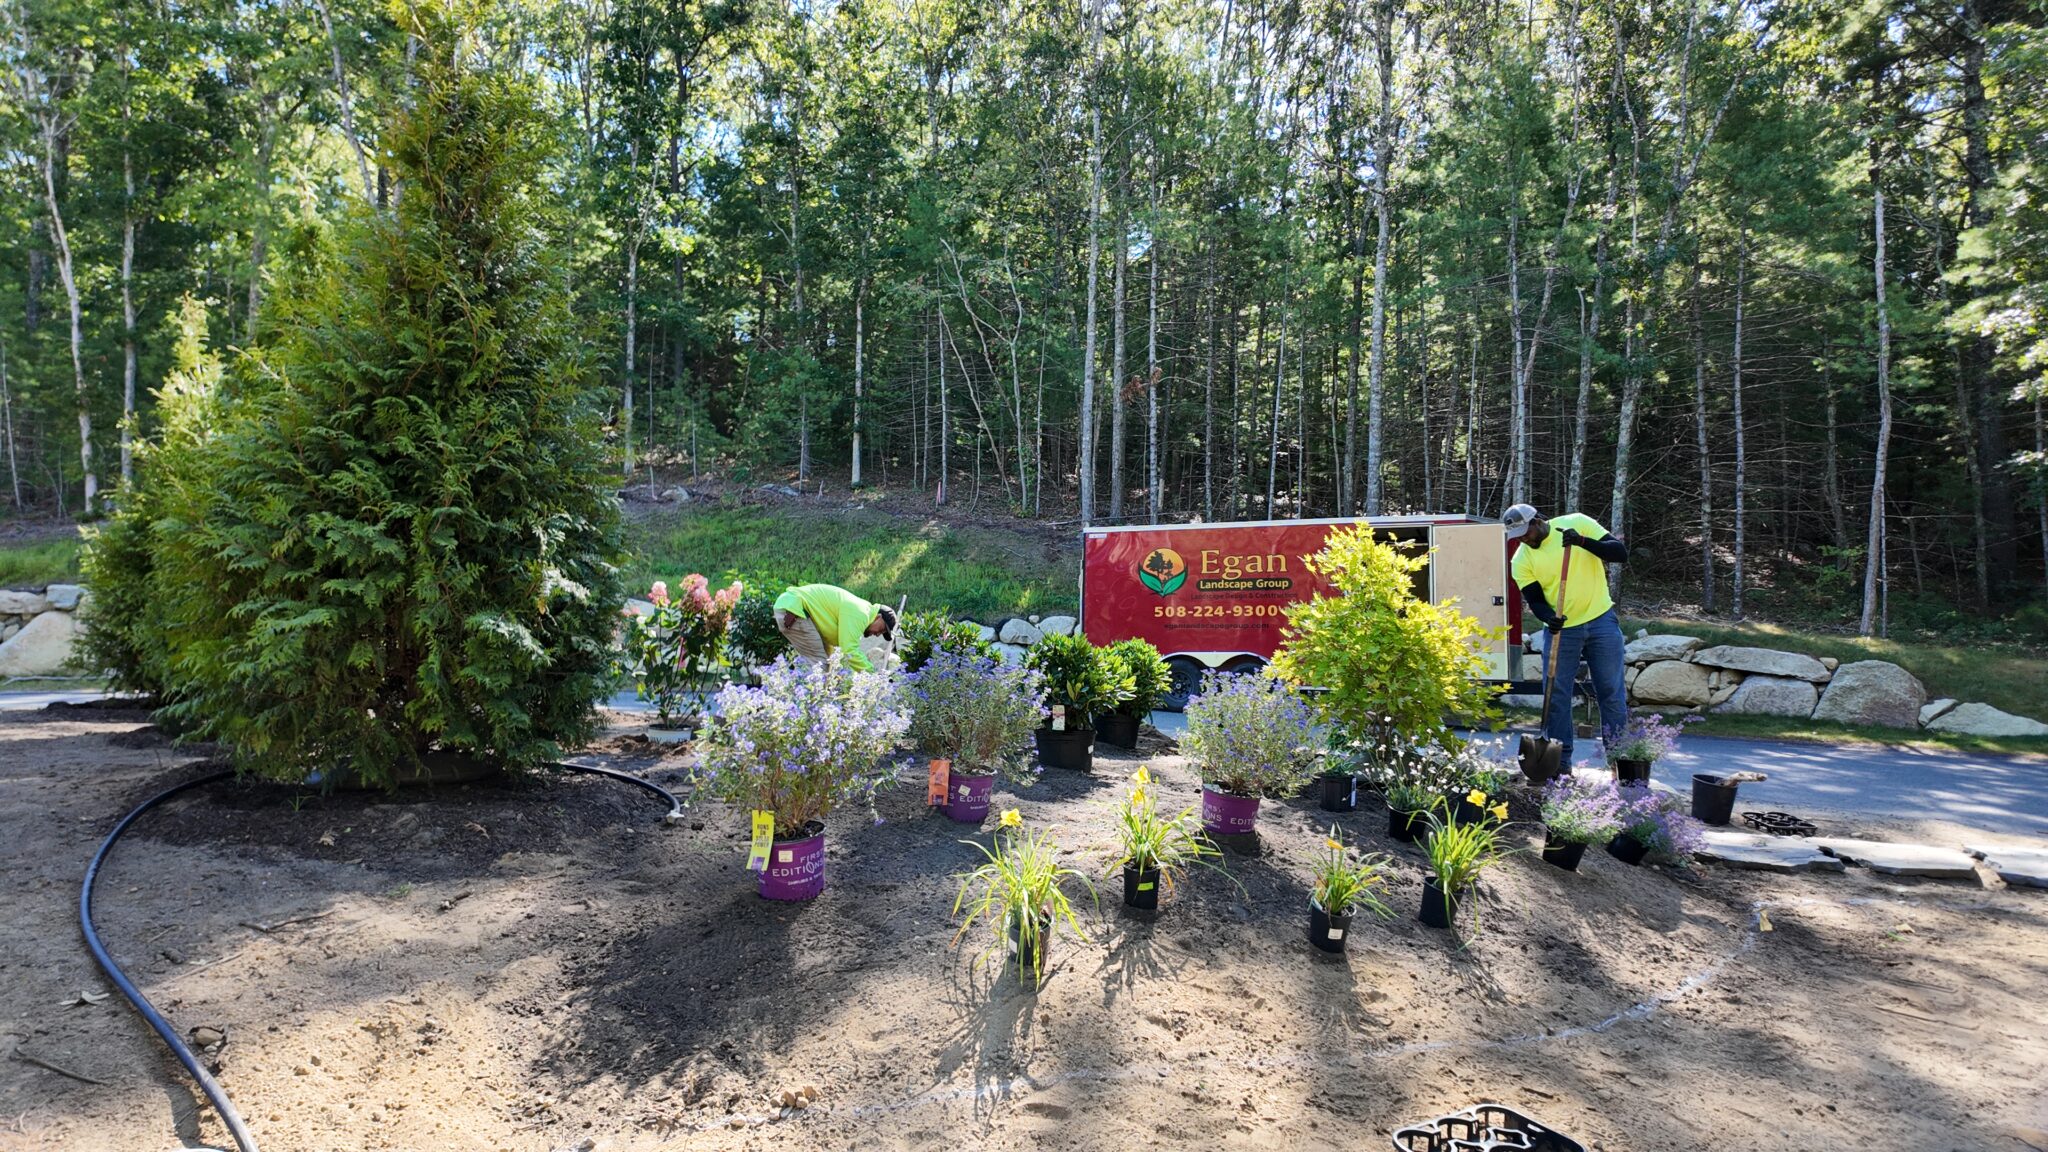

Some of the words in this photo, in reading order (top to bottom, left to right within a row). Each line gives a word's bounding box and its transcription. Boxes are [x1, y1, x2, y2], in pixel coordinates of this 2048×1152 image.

[1200, 549, 1288, 580] Egan
[1200, 579, 1253, 590] Landscape
[1256, 578, 1289, 590] Group
[1154, 605, 1278, 617] 508-224-9300
[772, 858, 824, 877] EDITIONS
